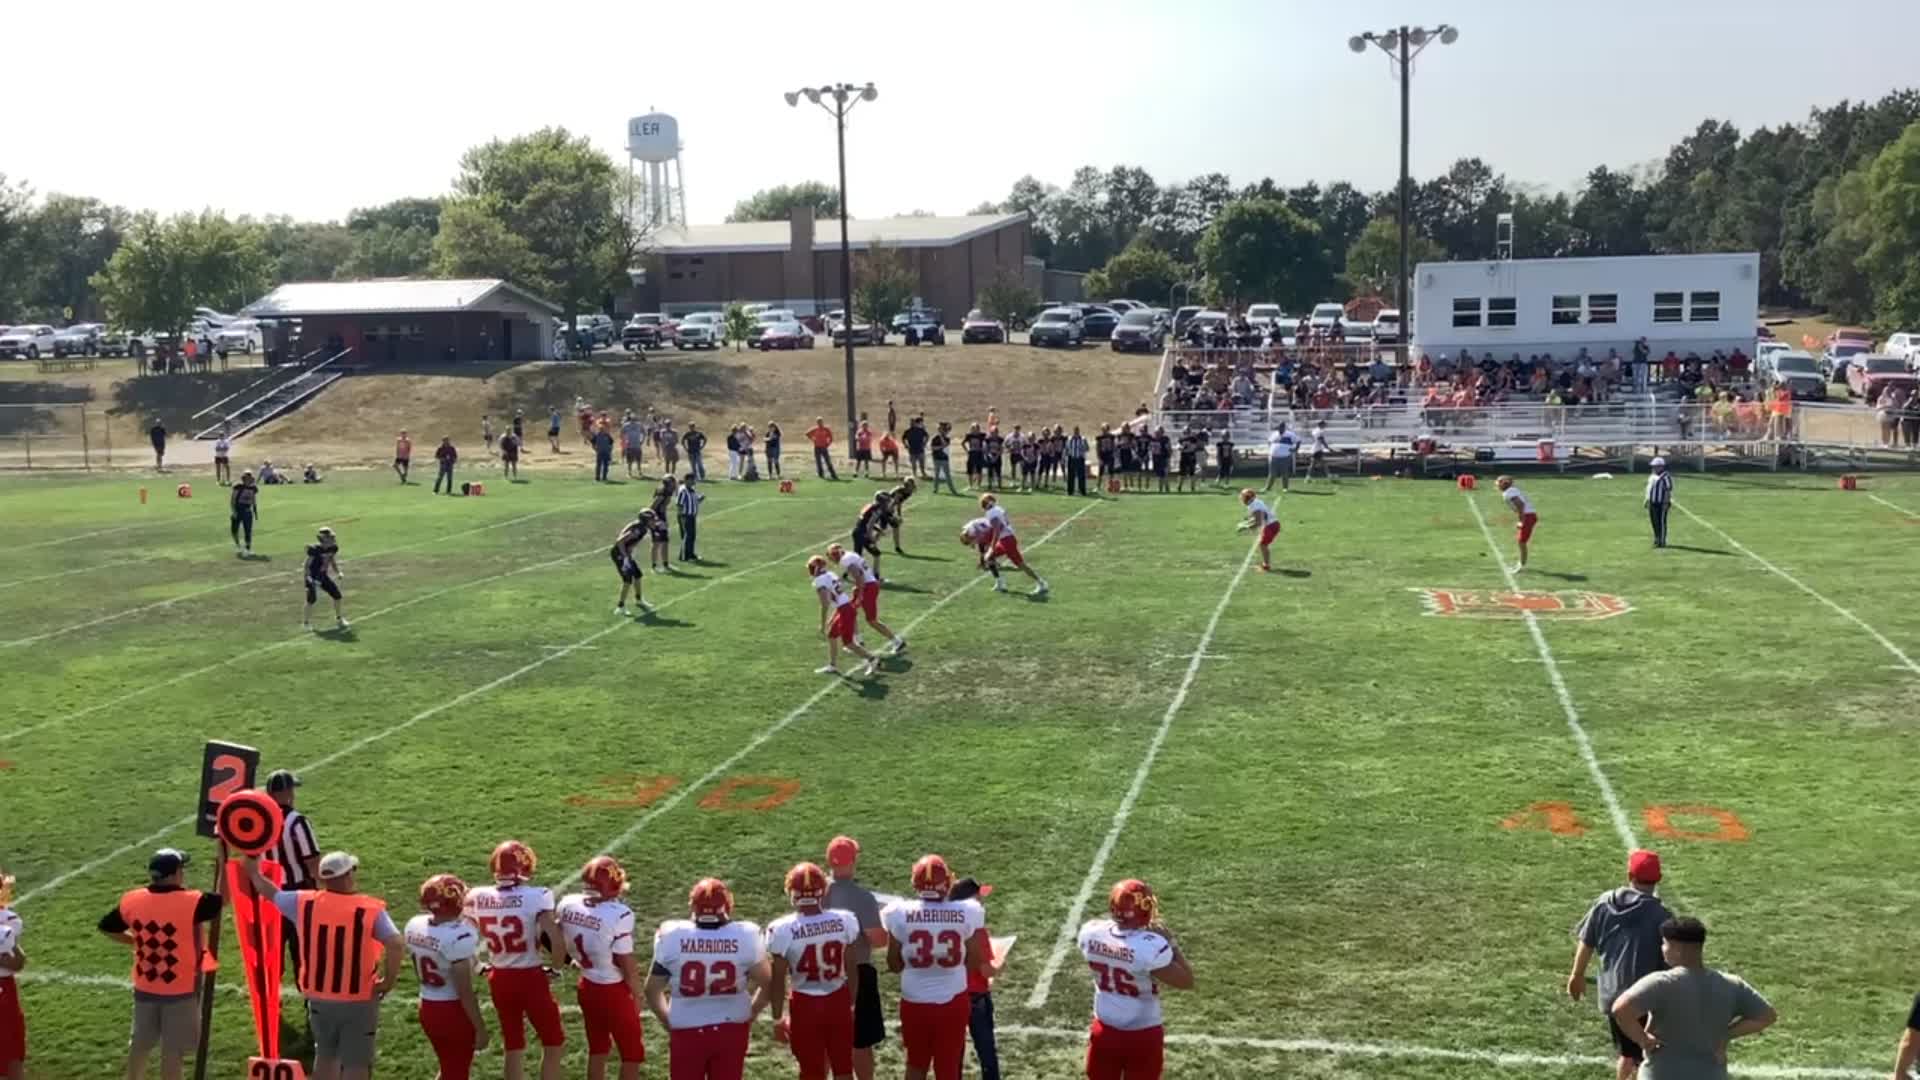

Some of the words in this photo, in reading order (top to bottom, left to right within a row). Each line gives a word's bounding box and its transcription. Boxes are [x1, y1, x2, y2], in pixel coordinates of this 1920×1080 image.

[208, 754, 246, 803] 2
[480, 916, 528, 953] 52
[791, 919, 845, 940] WARRIORS
[905, 909, 965, 924] WARRIORS
[680, 939, 738, 953] WARRIORS
[796, 940, 846, 982] 49
[908, 930, 962, 968] 33
[680, 961, 737, 997] 92
[1088, 961, 1140, 998] 76
